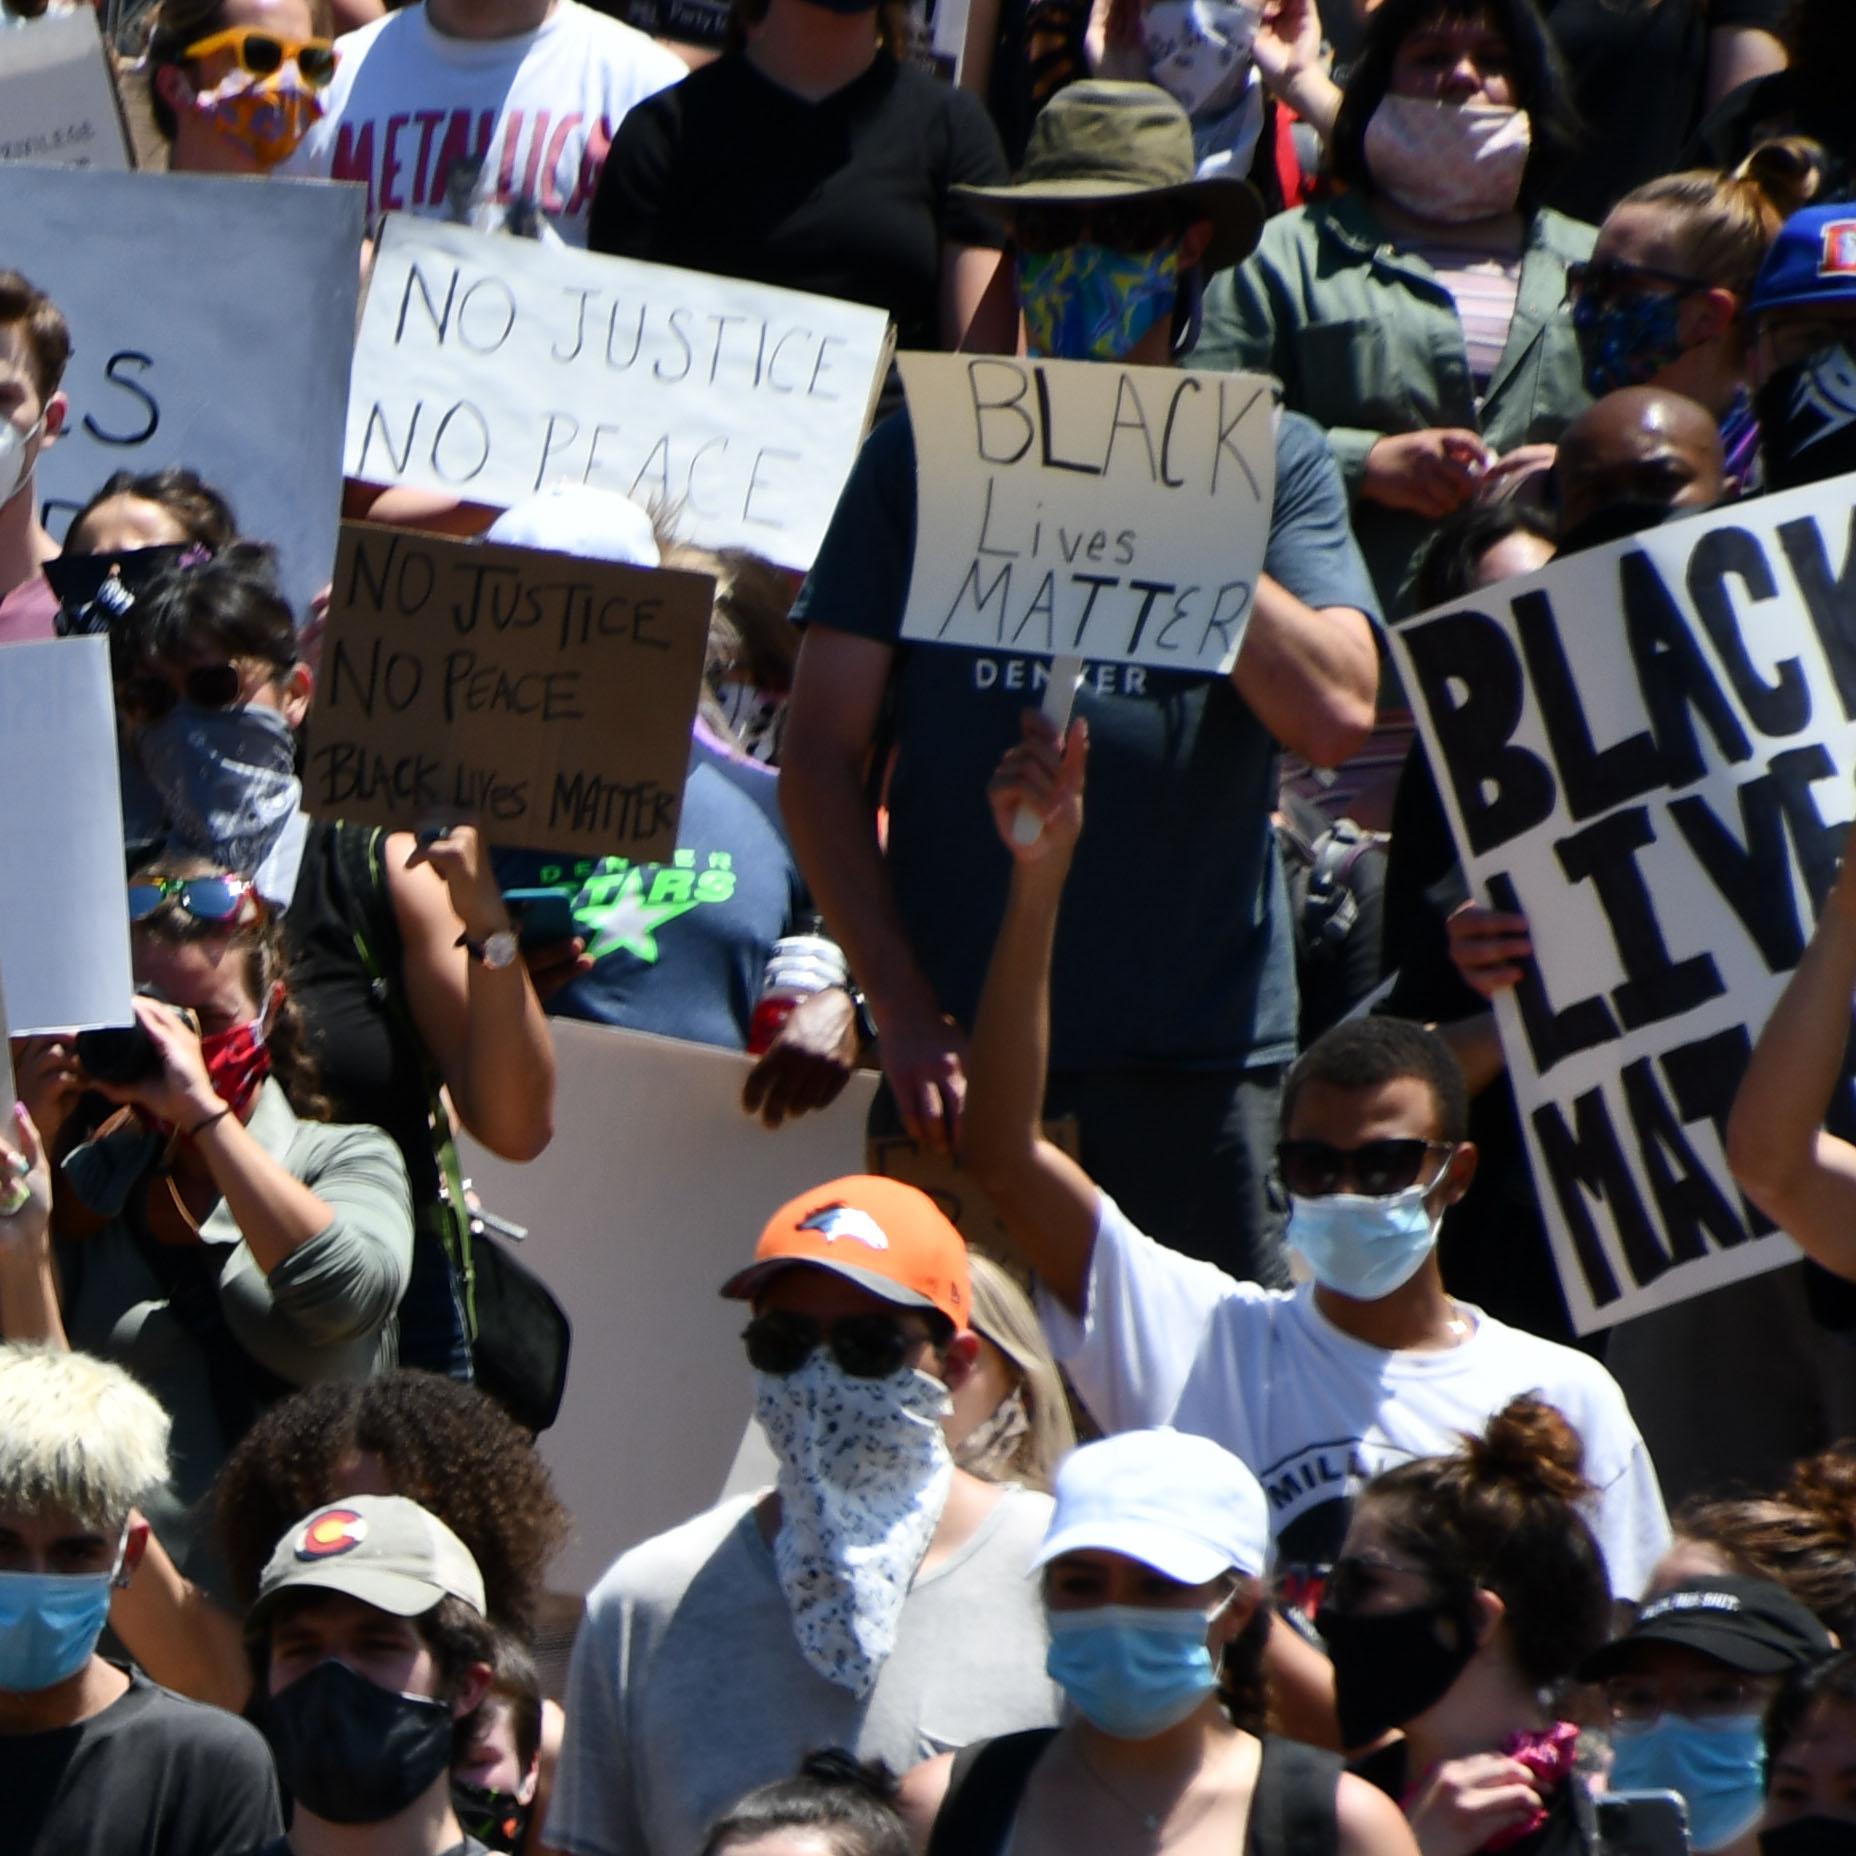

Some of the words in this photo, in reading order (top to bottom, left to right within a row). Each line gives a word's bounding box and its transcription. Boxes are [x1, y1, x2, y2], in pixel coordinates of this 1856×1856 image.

[393, 263, 517, 354] NO
[551, 285, 849, 401] JUSTICE
[356, 400, 490, 484] NO
[534, 412, 802, 529] PEACE
[968, 358, 1263, 503] BLACK
[977, 479, 1137, 566] Lives
[347, 535, 435, 616] NO
[452, 563, 671, 651] JUSTICE
[937, 557, 1255, 656] MATTER
[329, 637, 423, 719] NO
